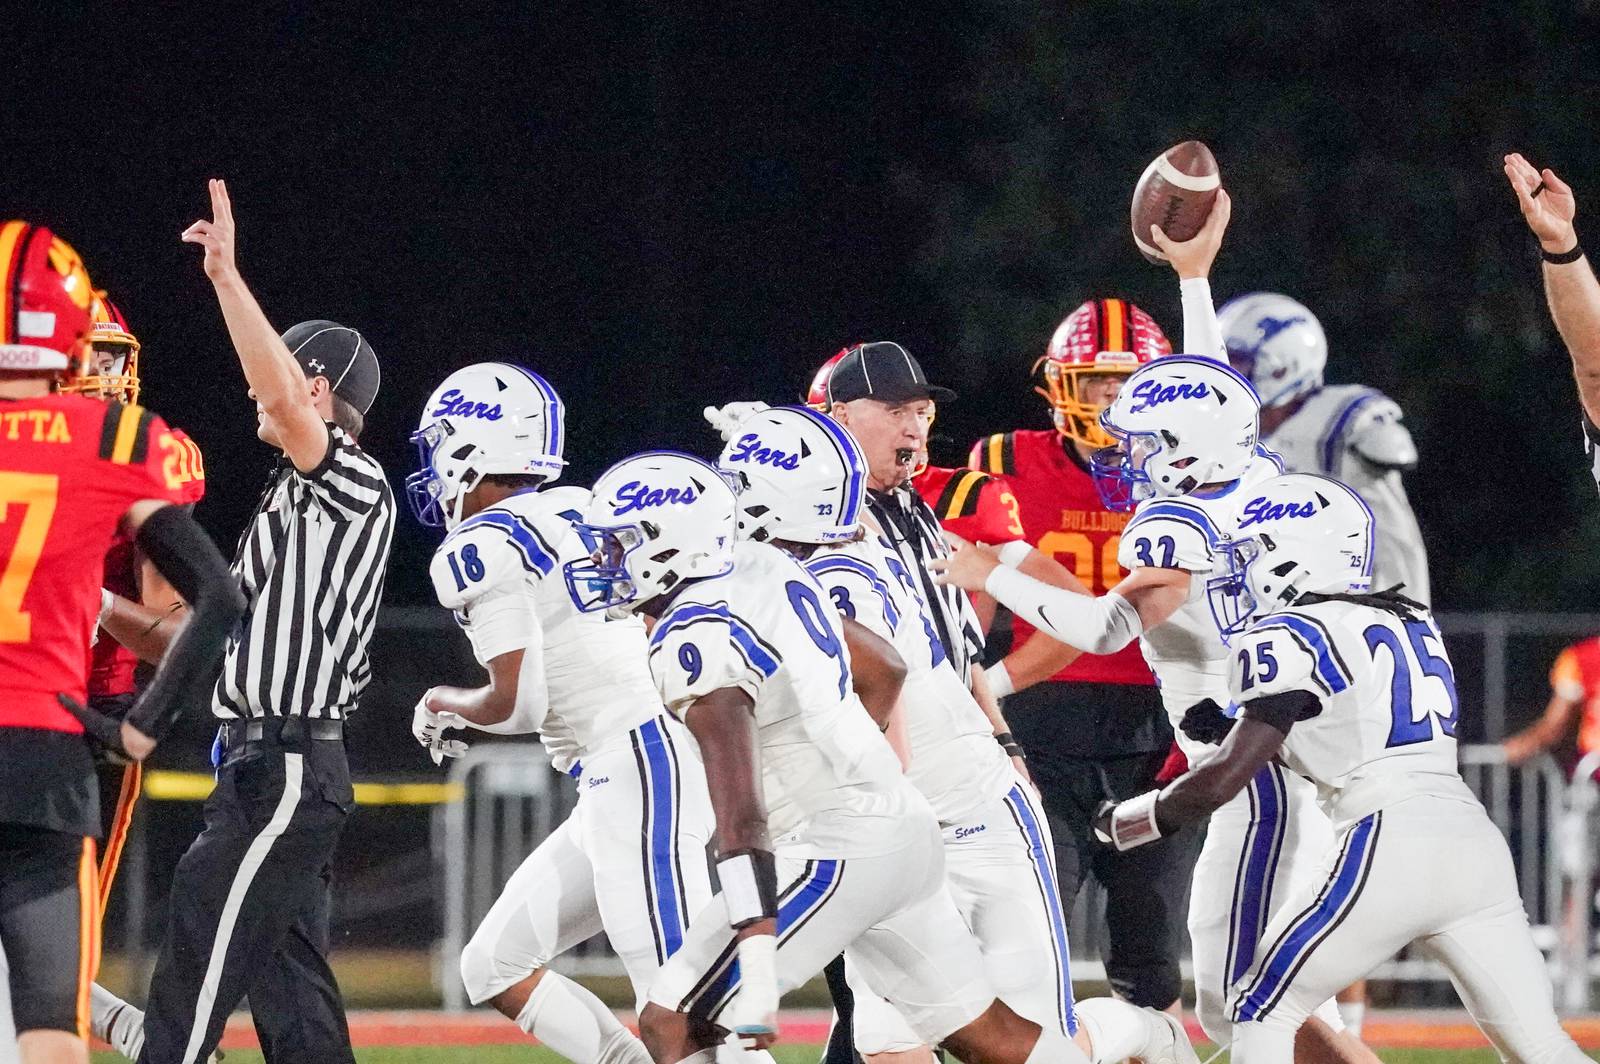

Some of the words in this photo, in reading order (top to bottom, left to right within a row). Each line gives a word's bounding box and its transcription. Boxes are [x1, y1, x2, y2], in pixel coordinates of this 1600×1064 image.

[432, 389, 503, 421] Stars
[1130, 379, 1210, 413] Stars
[0, 410, 71, 443] TTA
[729, 433, 800, 471] Stars
[613, 481, 697, 516] Stars
[817, 503, 833, 516] 23
[1238, 496, 1317, 529] Stars
[1061, 509, 1130, 532] BULLDOG
[447, 543, 485, 592] 18
[1135, 535, 1179, 569] 32
[1350, 555, 1362, 568] 25
[678, 642, 703, 687] 9
[1238, 640, 1278, 692] 25
[1362, 618, 1459, 750] 25
[955, 824, 986, 839] Stars
